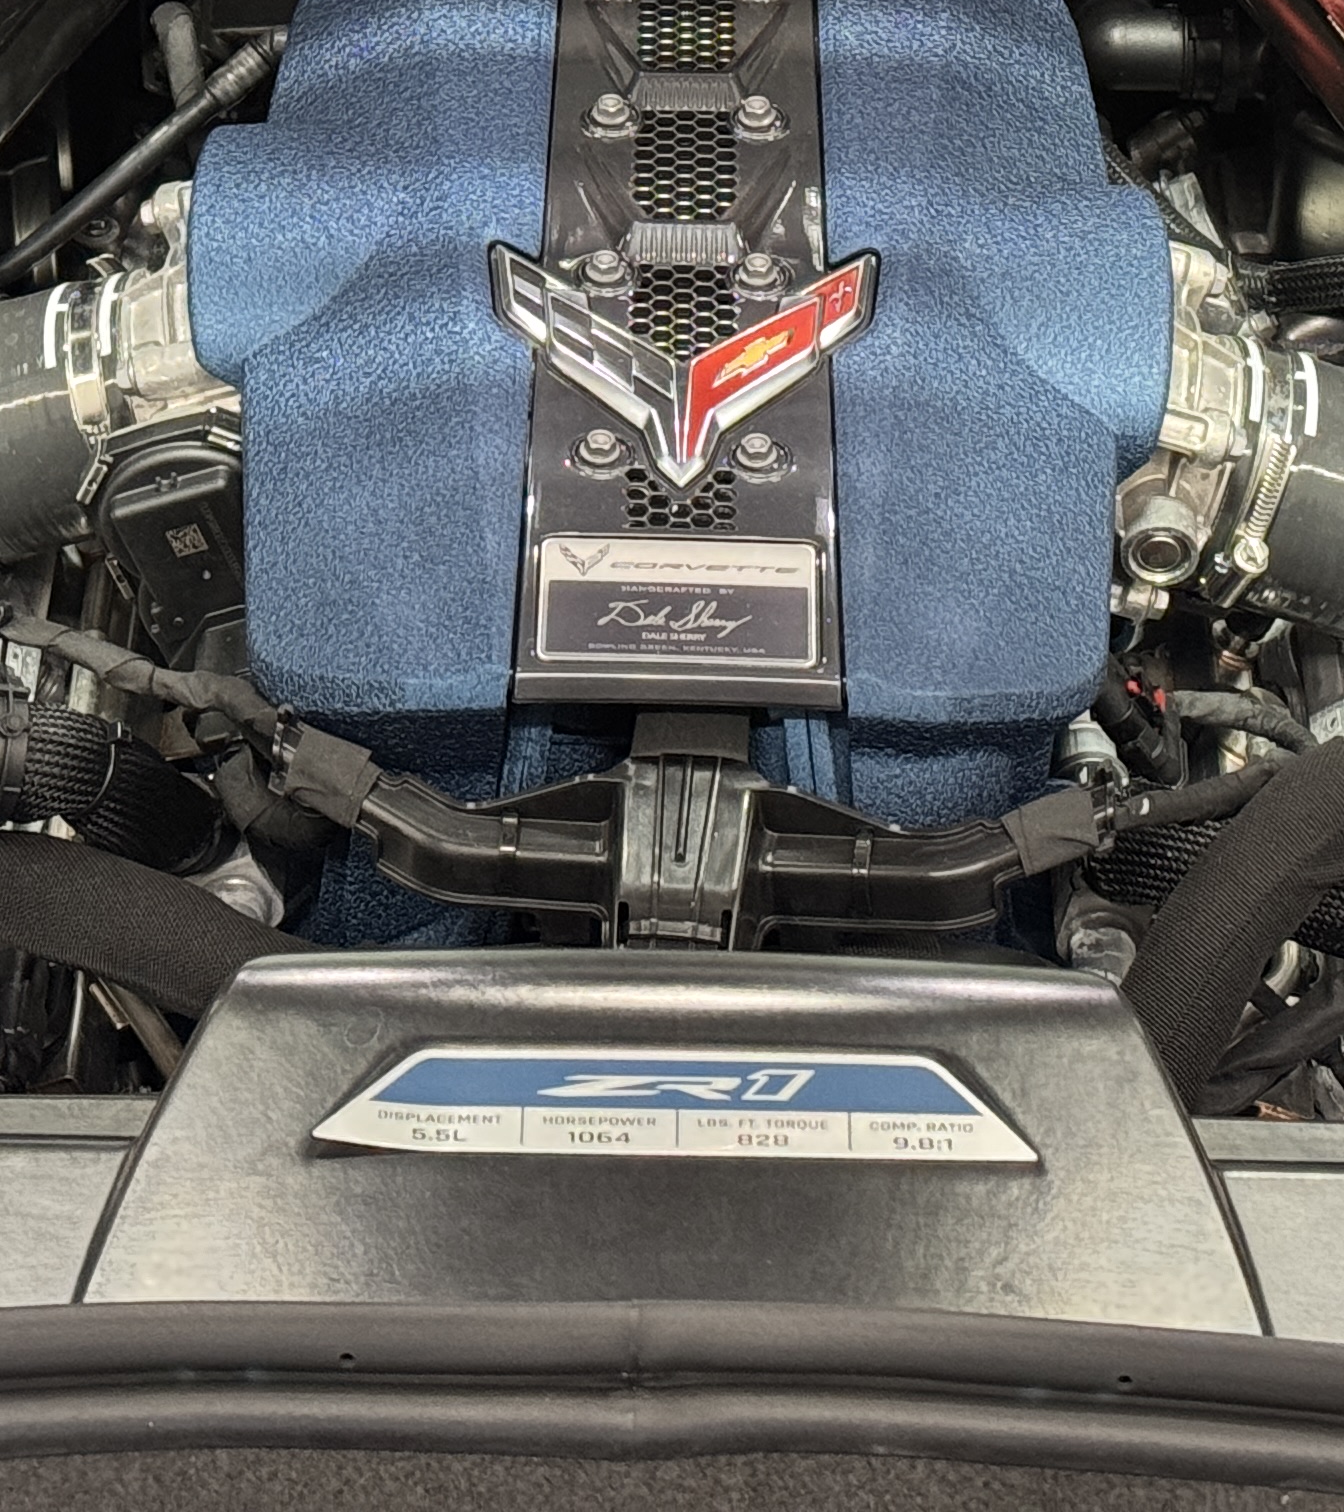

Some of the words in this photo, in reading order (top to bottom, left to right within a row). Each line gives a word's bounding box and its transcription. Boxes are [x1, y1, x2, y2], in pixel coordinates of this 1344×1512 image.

[610, 561, 801, 574] CORVETTE
[641, 631, 668, 641] DALE
[537, 1068, 816, 1102] ZR1
[377, 1108, 502, 1125] DISPLACEMENT
[542, 1114, 657, 1127] HORSEPOWER
[766, 1119, 829, 1130] TORQUE
[869, 1122, 922, 1132] COMP.
[926, 1122, 975, 1133] RATIO
[411, 1126, 468, 1142] 5.5L
[567, 1130, 631, 1145] 1064
[736, 1133, 790, 1147] 828
